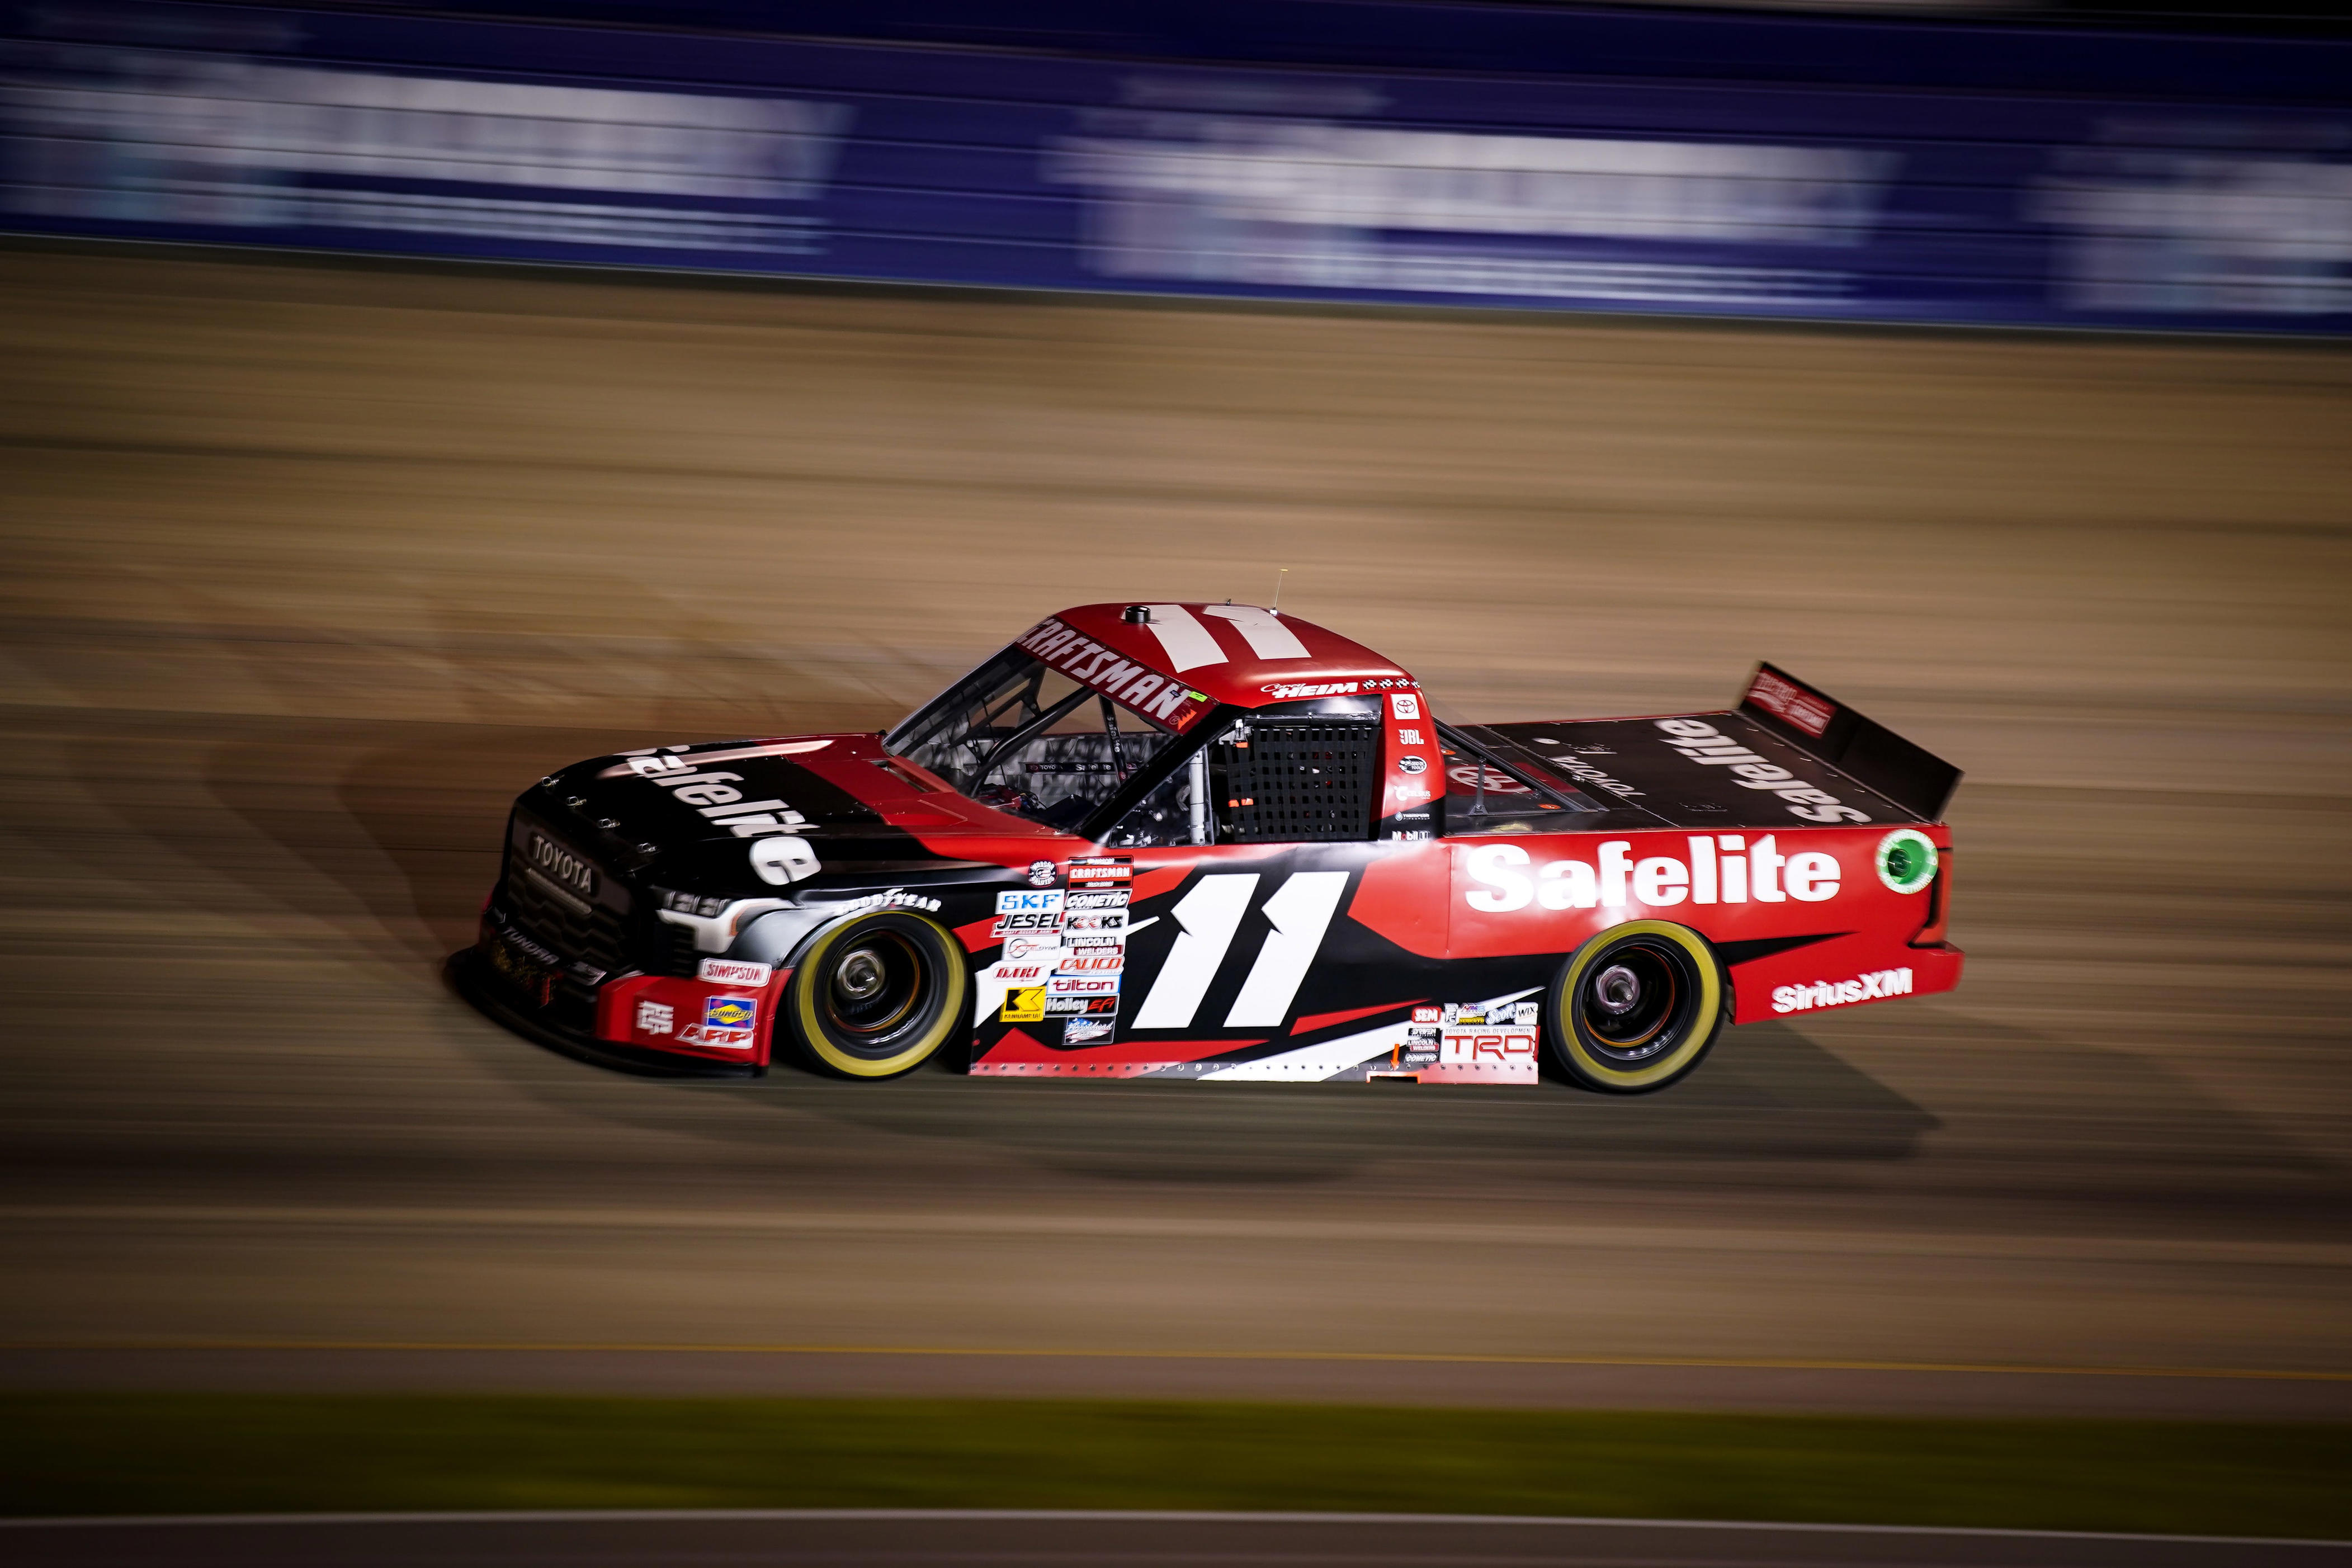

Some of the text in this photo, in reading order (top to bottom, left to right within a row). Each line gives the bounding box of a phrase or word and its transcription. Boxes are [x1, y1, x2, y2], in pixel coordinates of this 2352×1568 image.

[1121, 604, 1312, 674] 11
[1272, 682, 1358, 698] HEIM
[1398, 729, 1424, 745] JBL
[1653, 719, 1872, 823] Safelite
[1392, 830, 1418, 841] Mobil
[534, 835, 592, 893] TOYOTA
[1070, 867, 1130, 879] CRAFTSMAN
[1465, 834, 1841, 912] Safelite
[1002, 894, 1061, 910] SKF
[1066, 892, 1128, 908] COMETIC
[996, 913, 1062, 929] JESEL
[1069, 937, 1115, 947] LINCOLN
[1130, 871, 1350, 1029] 11
[1077, 947, 1119, 955] WELDERS
[707, 963, 764, 981] SIMPSON
[1060, 957, 1123, 971] CALICO
[1053, 979, 1114, 991] tilton
[1771, 967, 1912, 1013] SiriusXM
[1046, 997, 1116, 1014] Holley EFI
[1518, 1007, 1536, 1018] WIX
[1414, 1008, 1438, 1022] SEM
[679, 1026, 752, 1044] ARP
[1444, 1036, 1533, 1061] TRD
